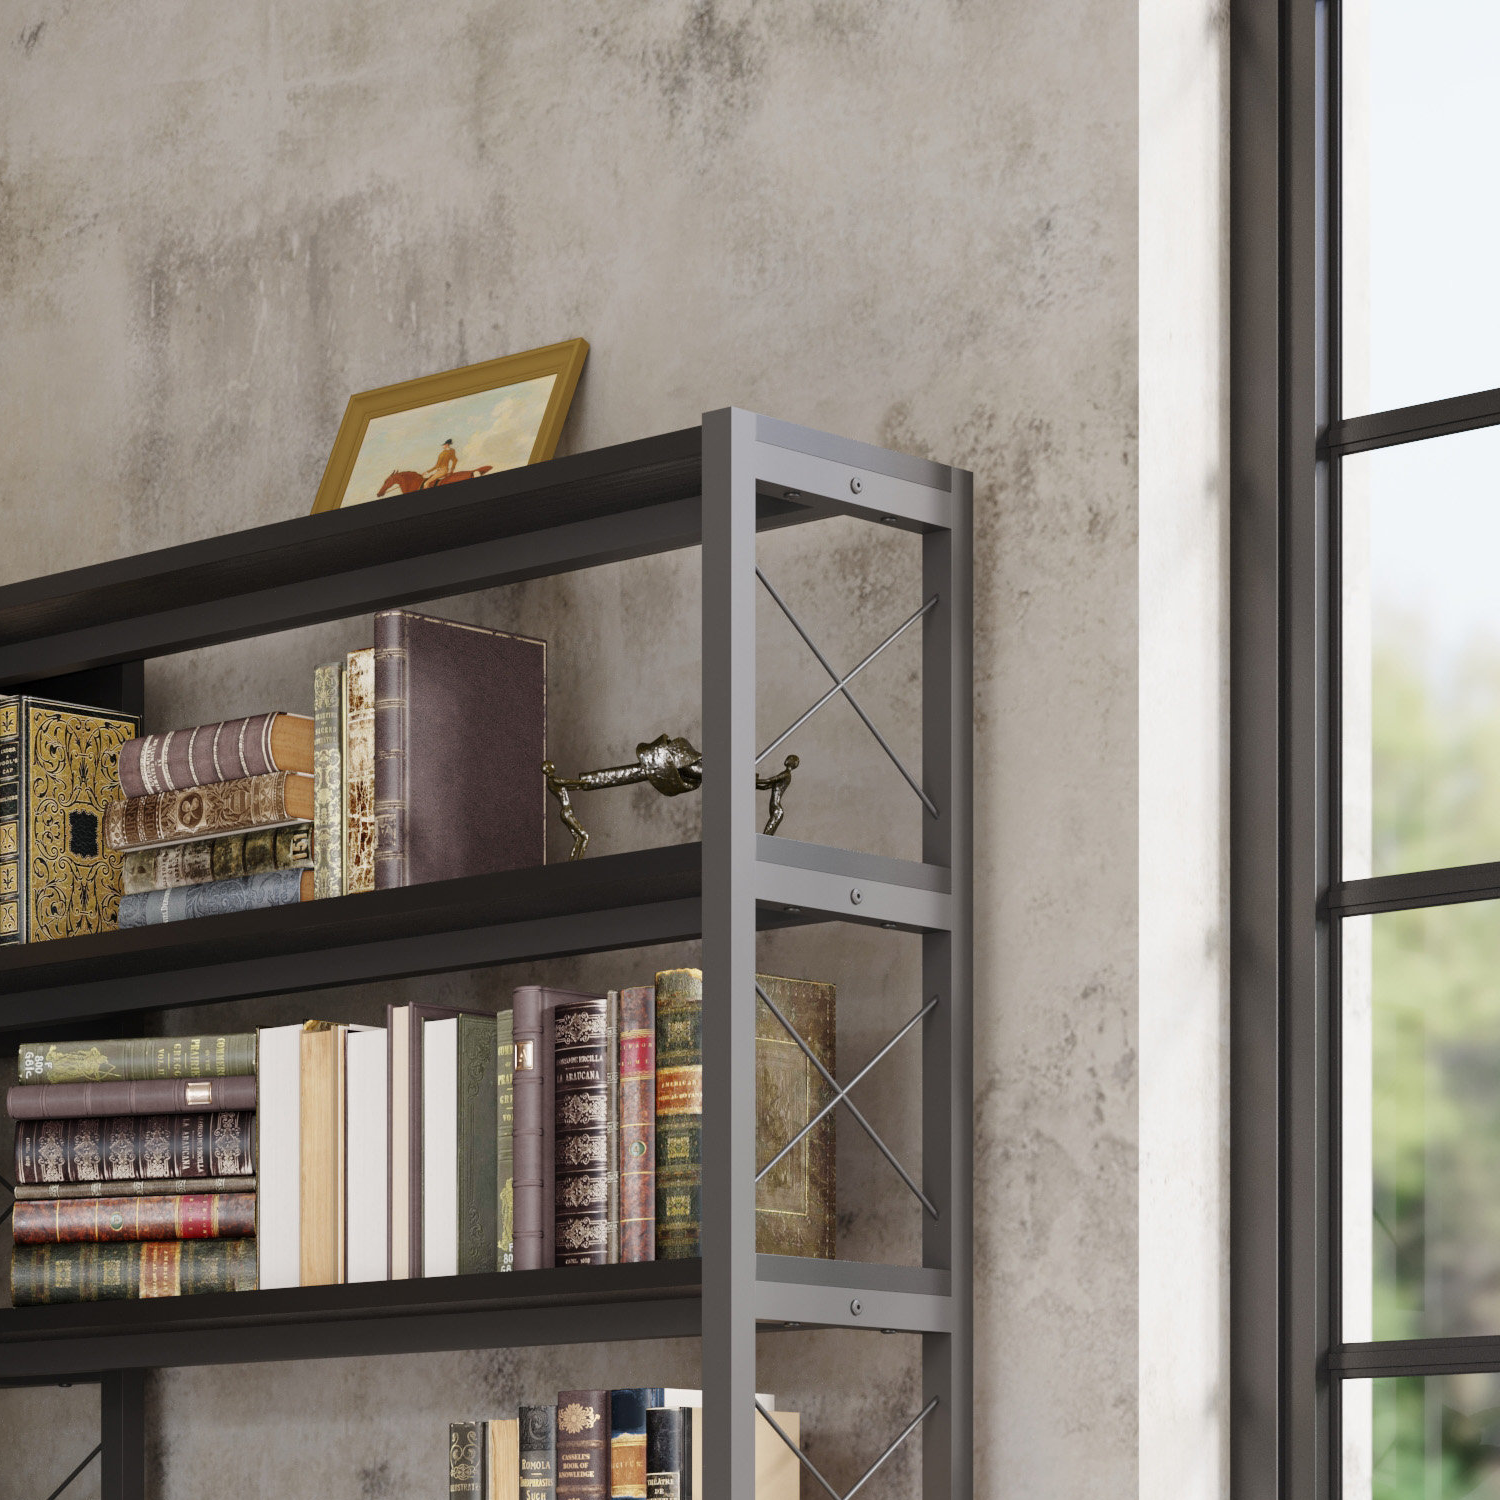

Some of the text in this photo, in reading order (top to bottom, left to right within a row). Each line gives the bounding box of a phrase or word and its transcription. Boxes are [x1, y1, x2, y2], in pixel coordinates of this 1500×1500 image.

[2, 767, 14, 775] CAP
[292, 833, 308, 860] 151
[578, 1054, 604, 1063] ERCILLA
[34, 1055, 44, 1074] 800
[44, 1061, 53, 1069] F
[565, 1070, 600, 1082] ARAUCANA
[521, 1459, 551, 1470] ROMOLA
[558, 1470, 595, 1478] KNOWLEDGE
